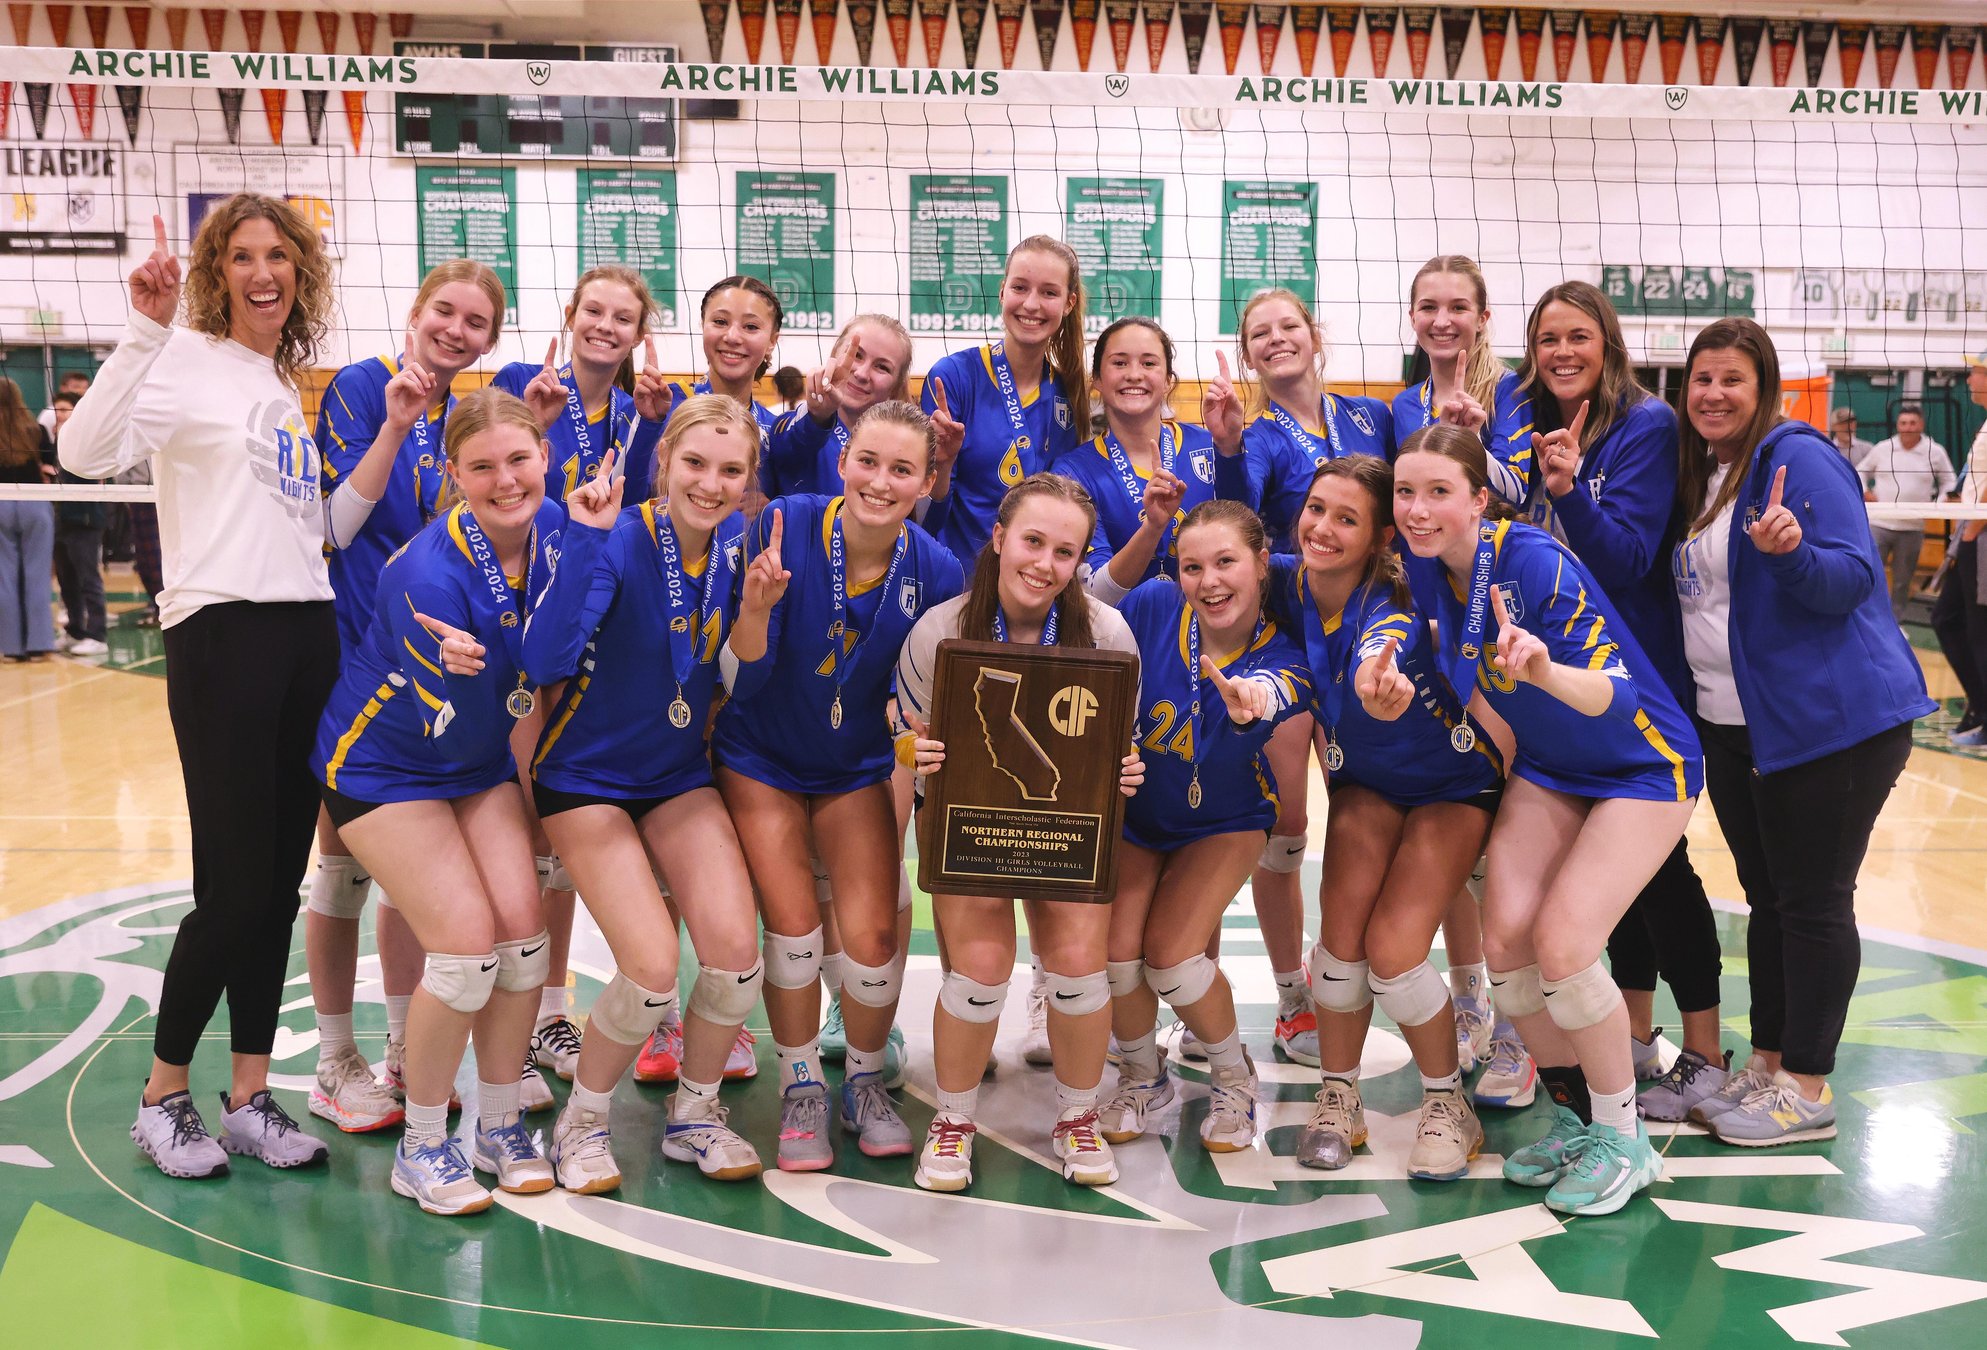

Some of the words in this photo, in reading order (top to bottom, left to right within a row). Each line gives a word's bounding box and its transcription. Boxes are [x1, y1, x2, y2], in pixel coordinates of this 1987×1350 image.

[70, 51, 211, 79] ARCHIE
[231, 55, 418, 84] WILLIAMS
[660, 65, 797, 92] ARCHIE
[819, 68, 999, 97] WILLIAMS
[1235, 77, 1367, 103] ARCHIE
[1389, 81, 1563, 108] WILLIAMS
[1789, 89, 1919, 114] ARCHIE
[1938, 91, 1987, 116] WI
[6, 149, 116, 176] LEAGUE
[997, 364, 1024, 430] 2023-2024
[567, 388, 594, 457] 2023-2024
[1274, 408, 1317, 454] 2023-2024
[1162, 433, 1172, 470] IONSHIPS
[280, 477, 316, 502] NIGHTS
[1109, 443, 1144, 504] 2023-2024
[465, 523, 509, 604] 2023-2024
[659, 528, 683, 608] 2023-2024
[832, 531, 843, 611] 2023-2024
[1467, 551, 1493, 634] CHAMPIONSHIPS
[1189, 615, 1199, 692] 2023-2024
[1048, 685, 1100, 737] CIF
[1142, 699, 1204, 763] 24
[953, 809, 992, 820] California
[995, 812, 1052, 824] Interscholastic
[1055, 816, 1095, 826] Federation
[961, 825, 1024, 838] NORTHERN
[1026, 830, 1085, 842] REGIONAL
[956, 855, 992, 863] DIVISION
[1006, 858, 1031, 866] GIRLS
[1033, 860, 1084, 869] VOLLEYBALL
[974, 837, 1069, 852] CHAMPIONSHIPS
[996, 865, 1043, 875] CHAMPIONS
